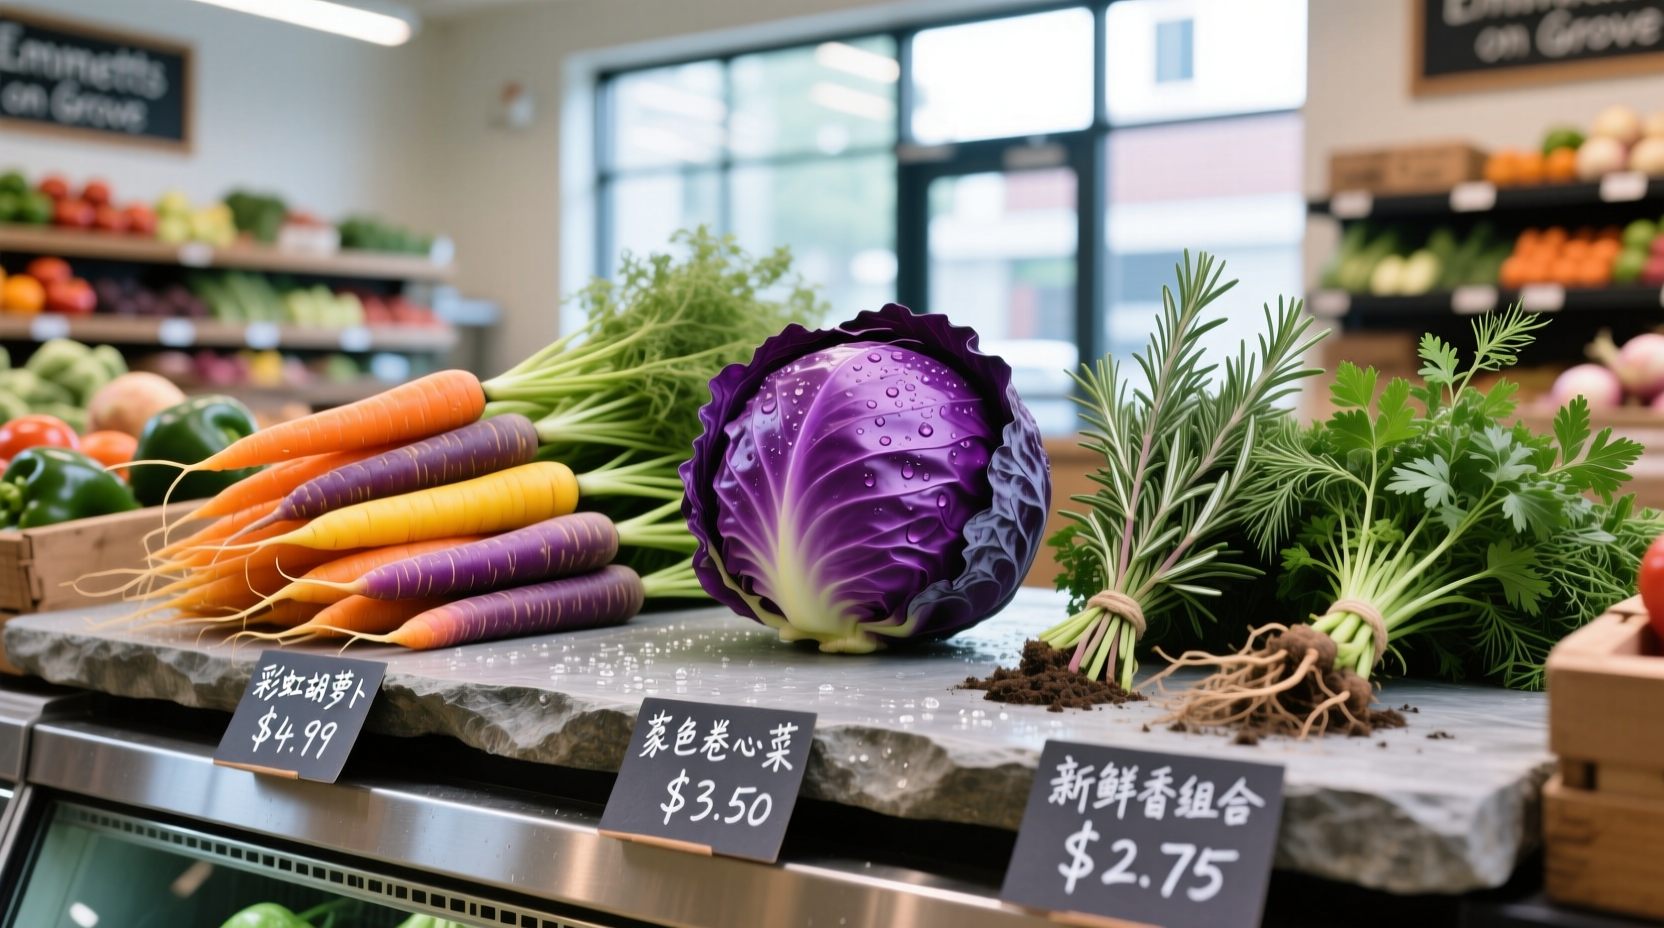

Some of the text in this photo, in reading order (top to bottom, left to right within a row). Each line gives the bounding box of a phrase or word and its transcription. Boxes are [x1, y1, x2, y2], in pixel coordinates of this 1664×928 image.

[1474, 23, 1531, 62] on
[1535, 7, 1663, 58] Grove
[1, 79, 148, 134] on Grove
[252, 664, 365, 710] 彩虹胡萝卜
[252, 705, 338, 760] $4.99
[660, 768, 772, 826] $3.50
[1048, 755, 1266, 826] 新鲜香组合
[1058, 820, 1240, 902] $2.75
